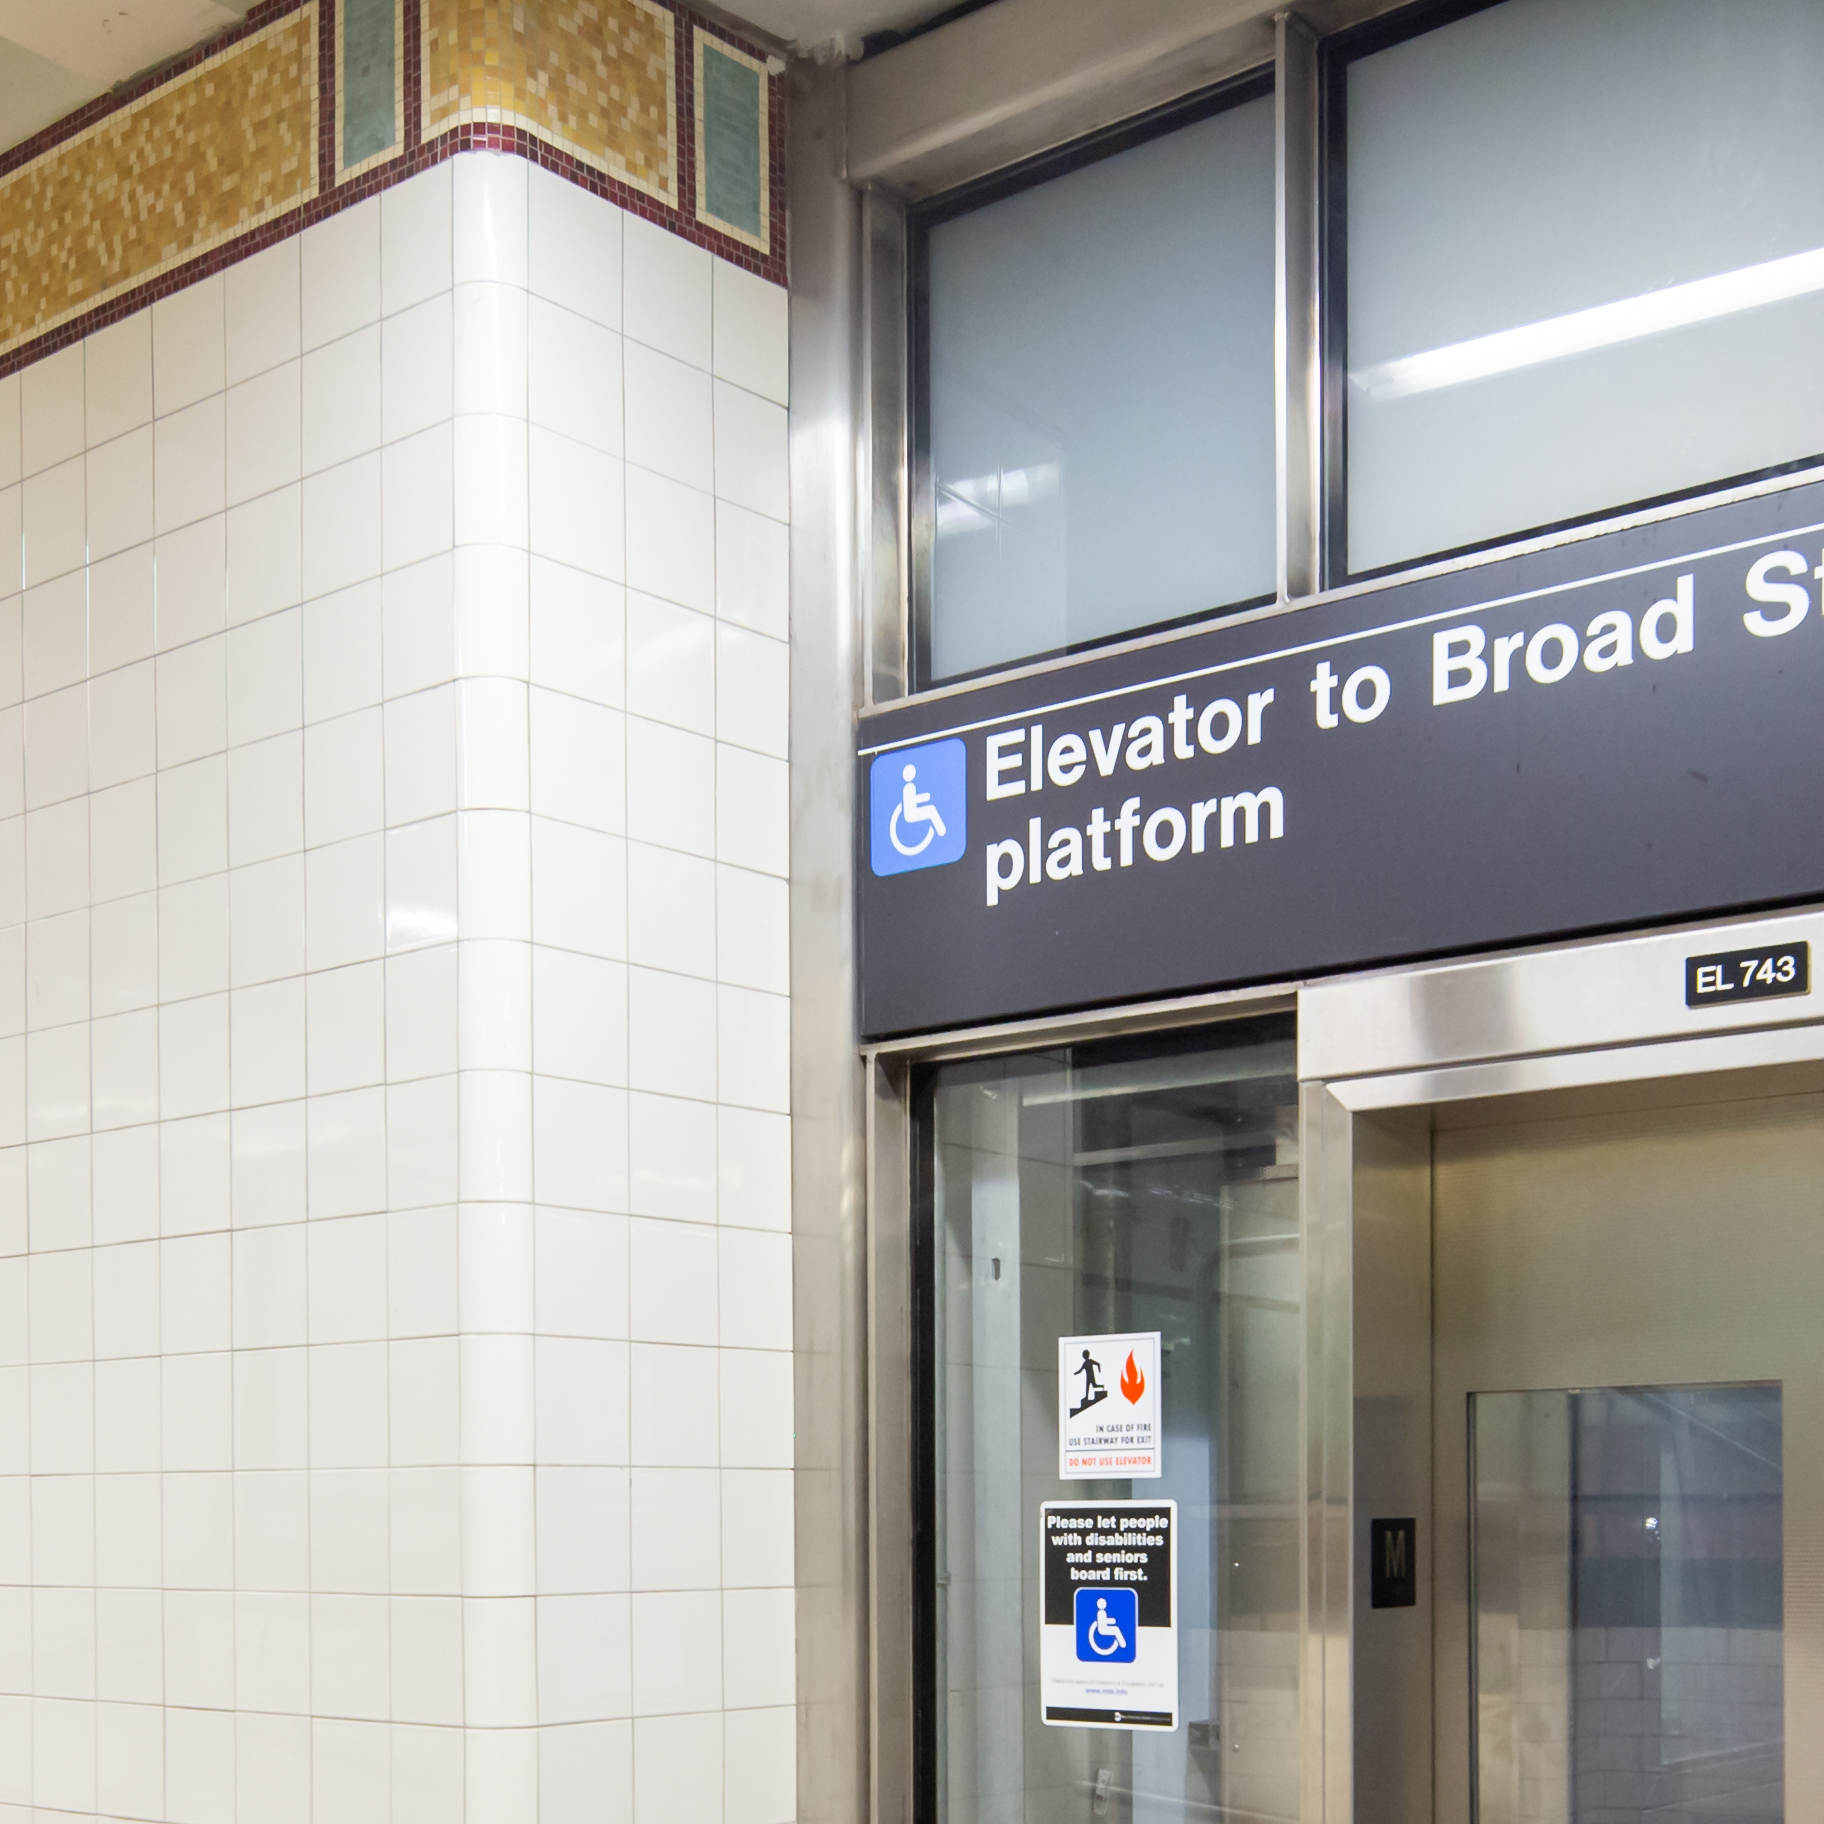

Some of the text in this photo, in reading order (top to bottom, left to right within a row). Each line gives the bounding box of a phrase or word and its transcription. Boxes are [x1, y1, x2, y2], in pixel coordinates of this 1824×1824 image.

[986, 687, 1275, 801] Elevator
[1310, 660, 1391, 730] to
[1432, 573, 1695, 707] Broad
[986, 786, 1285, 907] platform
[1696, 955, 1797, 994] EL 743
[1096, 1423, 1152, 1433] IN CASE OF FIRE
[1069, 1435, 1152, 1446] USE STAIRWAY FOR EXIT
[1069, 1456, 1152, 1467] DO NOT USE ELEVATOR
[1047, 1514, 1169, 1531] Please let people
[1051, 1532, 1164, 1546] with disabilities
[1066, 1549, 1148, 1564] and seniors
[1384, 1529, 1407, 1579] M
[1070, 1566, 1148, 1581] board first.
